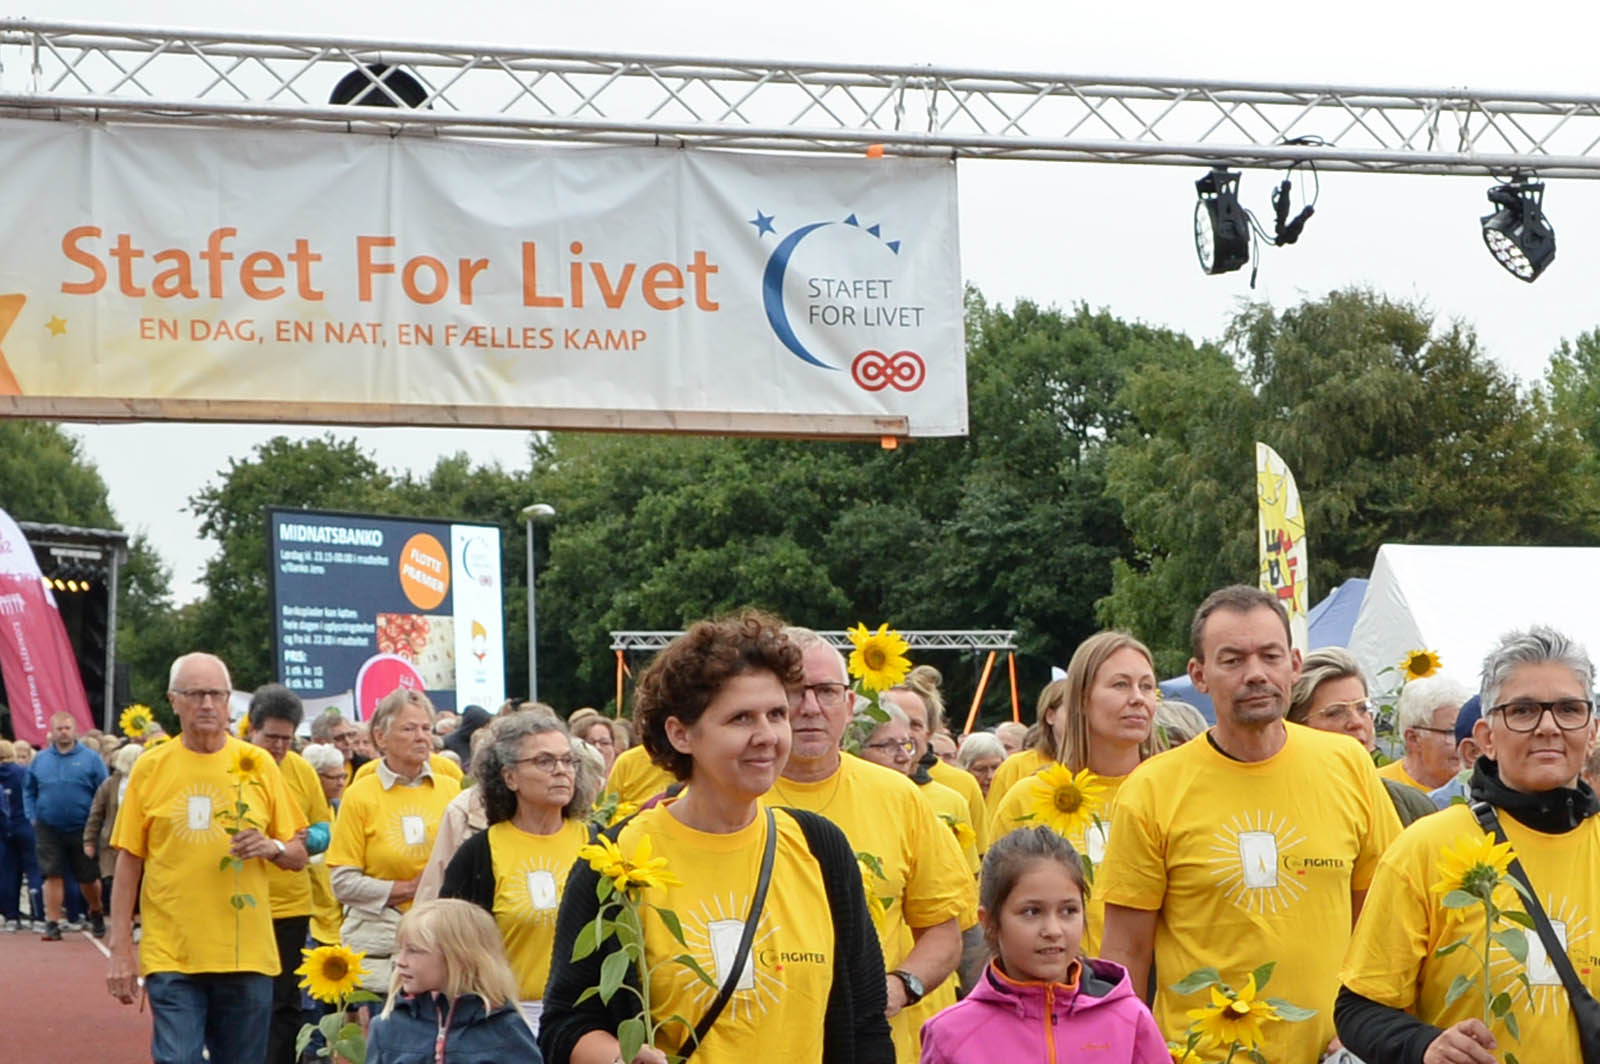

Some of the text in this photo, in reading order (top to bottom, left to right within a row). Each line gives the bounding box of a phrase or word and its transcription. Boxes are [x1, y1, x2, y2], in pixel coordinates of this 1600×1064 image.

[59, 225, 720, 313] Stafet For Livet
[808, 277, 893, 299] STAFET
[809, 304, 925, 327] FOR LIVET
[139, 317, 648, 351] EN DAG, EN NAT, EN FÆLLES KAMP
[279, 522, 385, 548] MIDNATSBANKO
[1303, 857, 1344, 868] FIGHTER
[780, 951, 826, 965] FIGHTER
